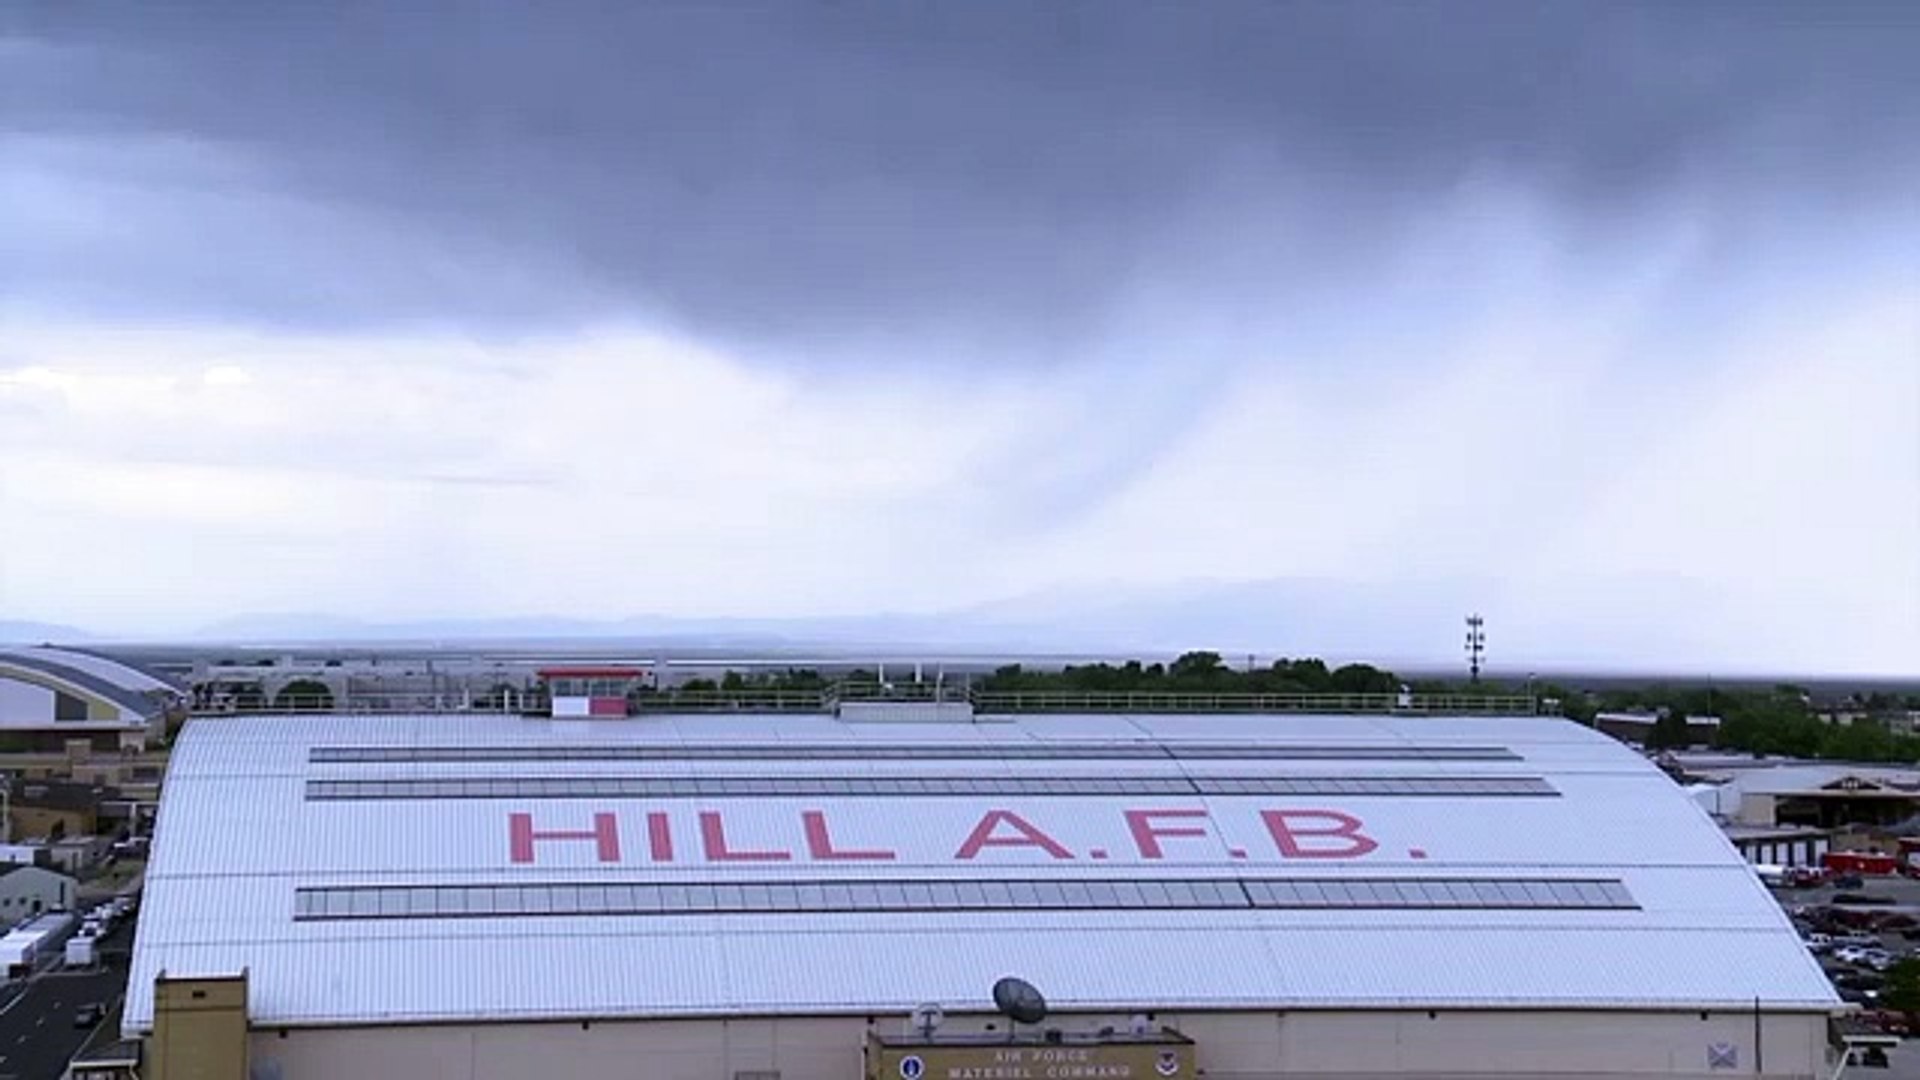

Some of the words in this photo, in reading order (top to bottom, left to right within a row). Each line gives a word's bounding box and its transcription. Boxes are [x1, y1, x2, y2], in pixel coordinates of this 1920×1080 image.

[509, 811, 896, 863] HILL
[954, 810, 1427, 859] A.F.B.
[995, 1050, 1022, 1062] AIR
[1032, 1049, 1088, 1062] FORCE
[949, 1067, 1031, 1079] MATERIEL
[1046, 1065, 1131, 1078] COMMAND
